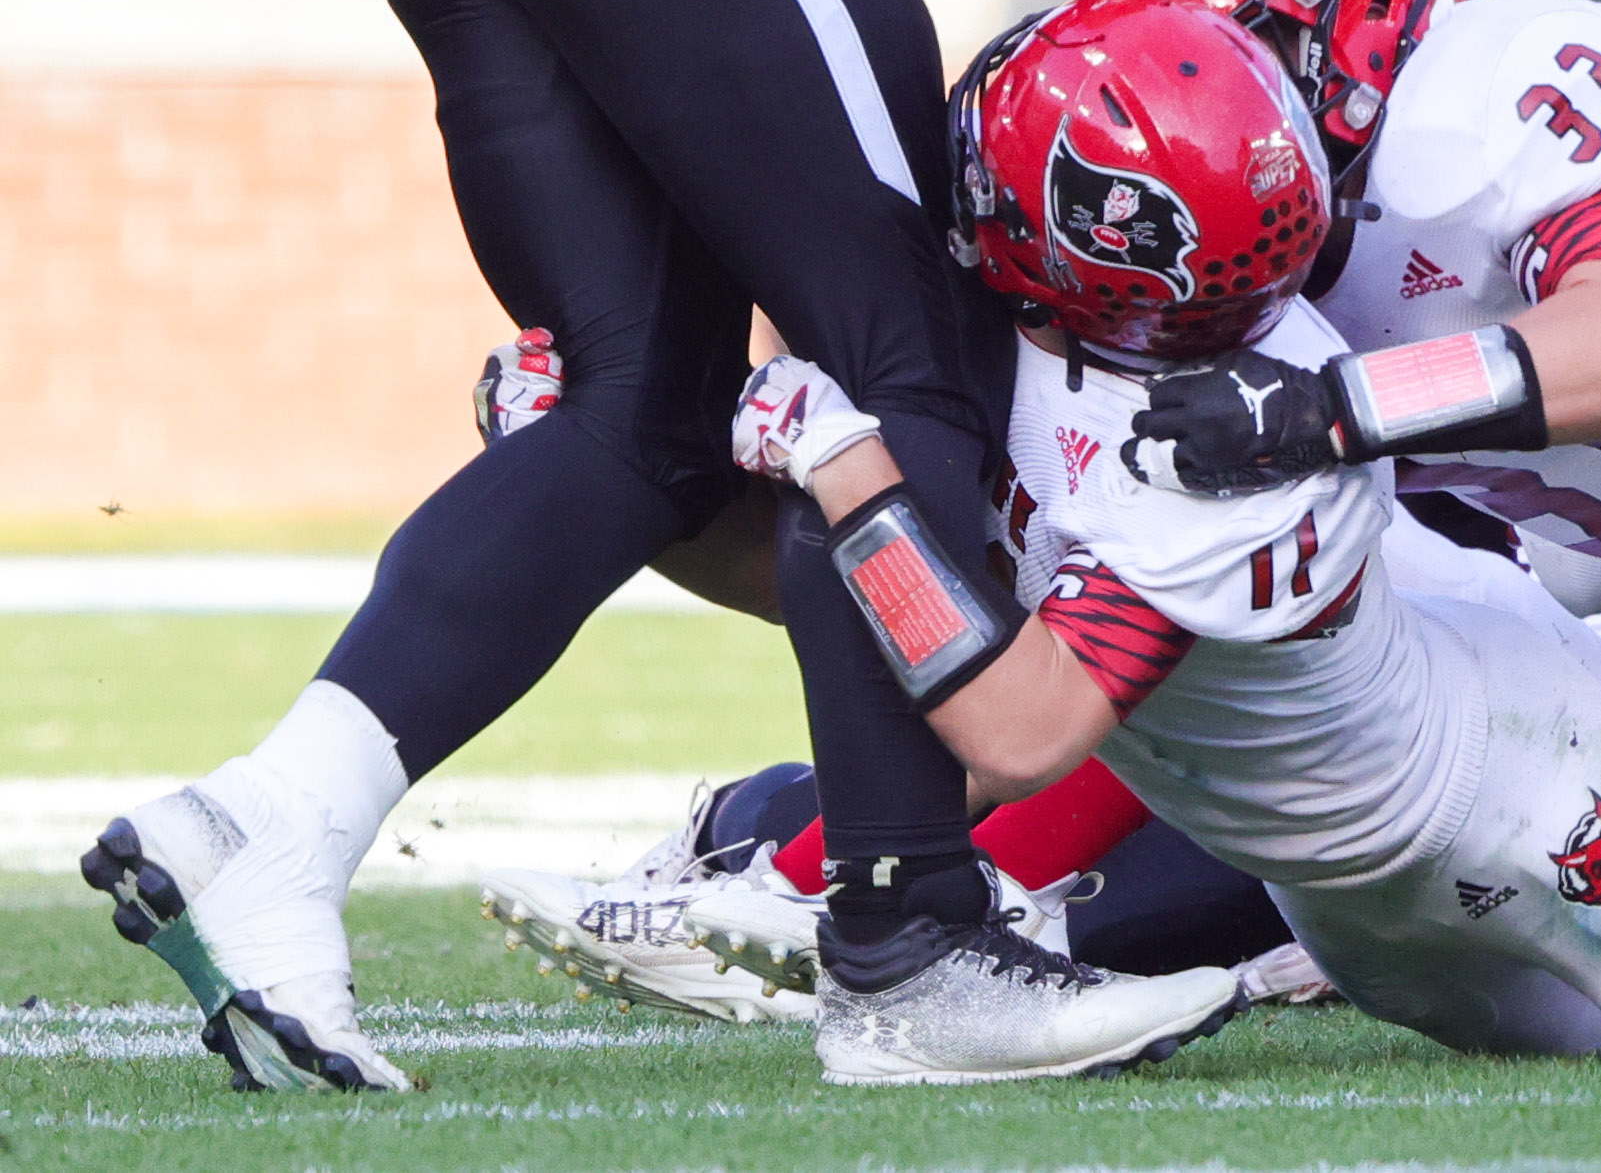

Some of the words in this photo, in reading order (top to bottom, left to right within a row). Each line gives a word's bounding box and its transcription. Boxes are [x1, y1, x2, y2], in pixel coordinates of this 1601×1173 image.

[1400, 274, 1464, 301] adidas
[1055, 426, 1079, 496] adidas
[1249, 508, 1318, 611] 11
[1467, 885, 1519, 921] adidas
